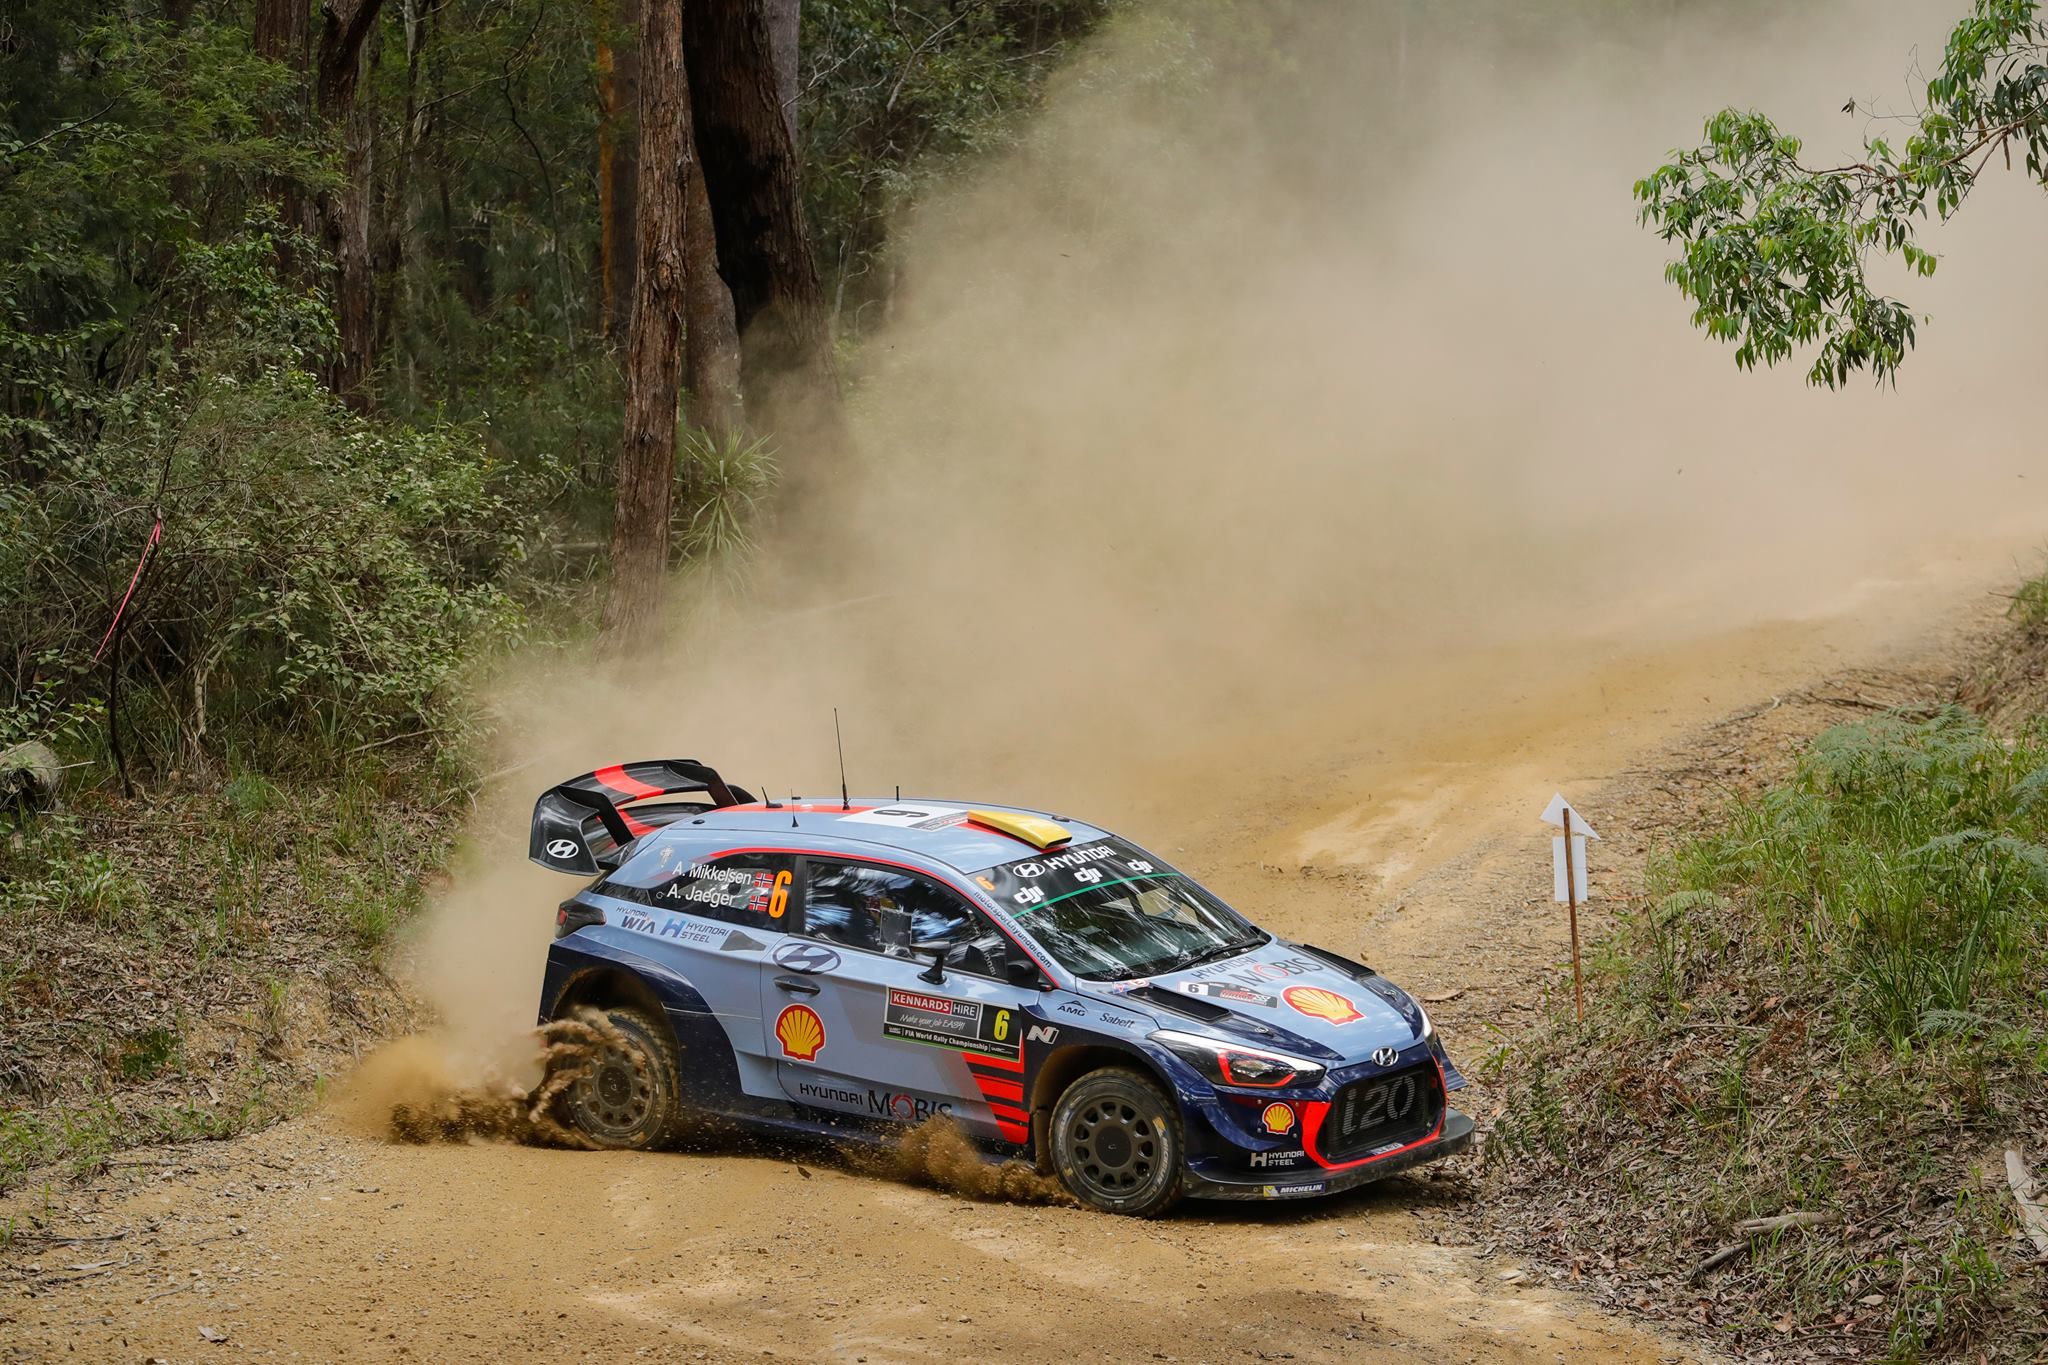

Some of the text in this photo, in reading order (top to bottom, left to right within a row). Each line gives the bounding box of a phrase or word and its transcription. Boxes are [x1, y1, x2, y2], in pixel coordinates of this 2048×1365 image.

[1043, 845, 1117, 870] HYUNDAI
[672, 861, 752, 885] A. Mikkelsen
[667, 883, 735, 908] A. Jaeger
[768, 870, 793, 919] 6
[1013, 885, 1045, 904] dji
[616, 906, 648, 918] HYUNDAI
[621, 915, 656, 934] WIA
[685, 922, 730, 937] HYUNDAI
[680, 931, 710, 943] STEEL
[1190, 956, 1258, 979] HYUNDAI
[1228, 957, 1324, 987] MOBIS
[1188, 983, 1200, 993] 6
[893, 993, 976, 1016] KENNARDS HIRE
[993, 1009, 1010, 1041] 6
[905, 1029, 915, 1038] FIA
[915, 1031, 932, 1041] World
[933, 1035, 948, 1044] Rally
[948, 1037, 989, 1052] Championship
[800, 1083, 863, 1105] HYUNDAI
[1268, 1150, 1305, 1159] HYUNDAI
[1280, 1184, 1323, 1193] MICHELIN
